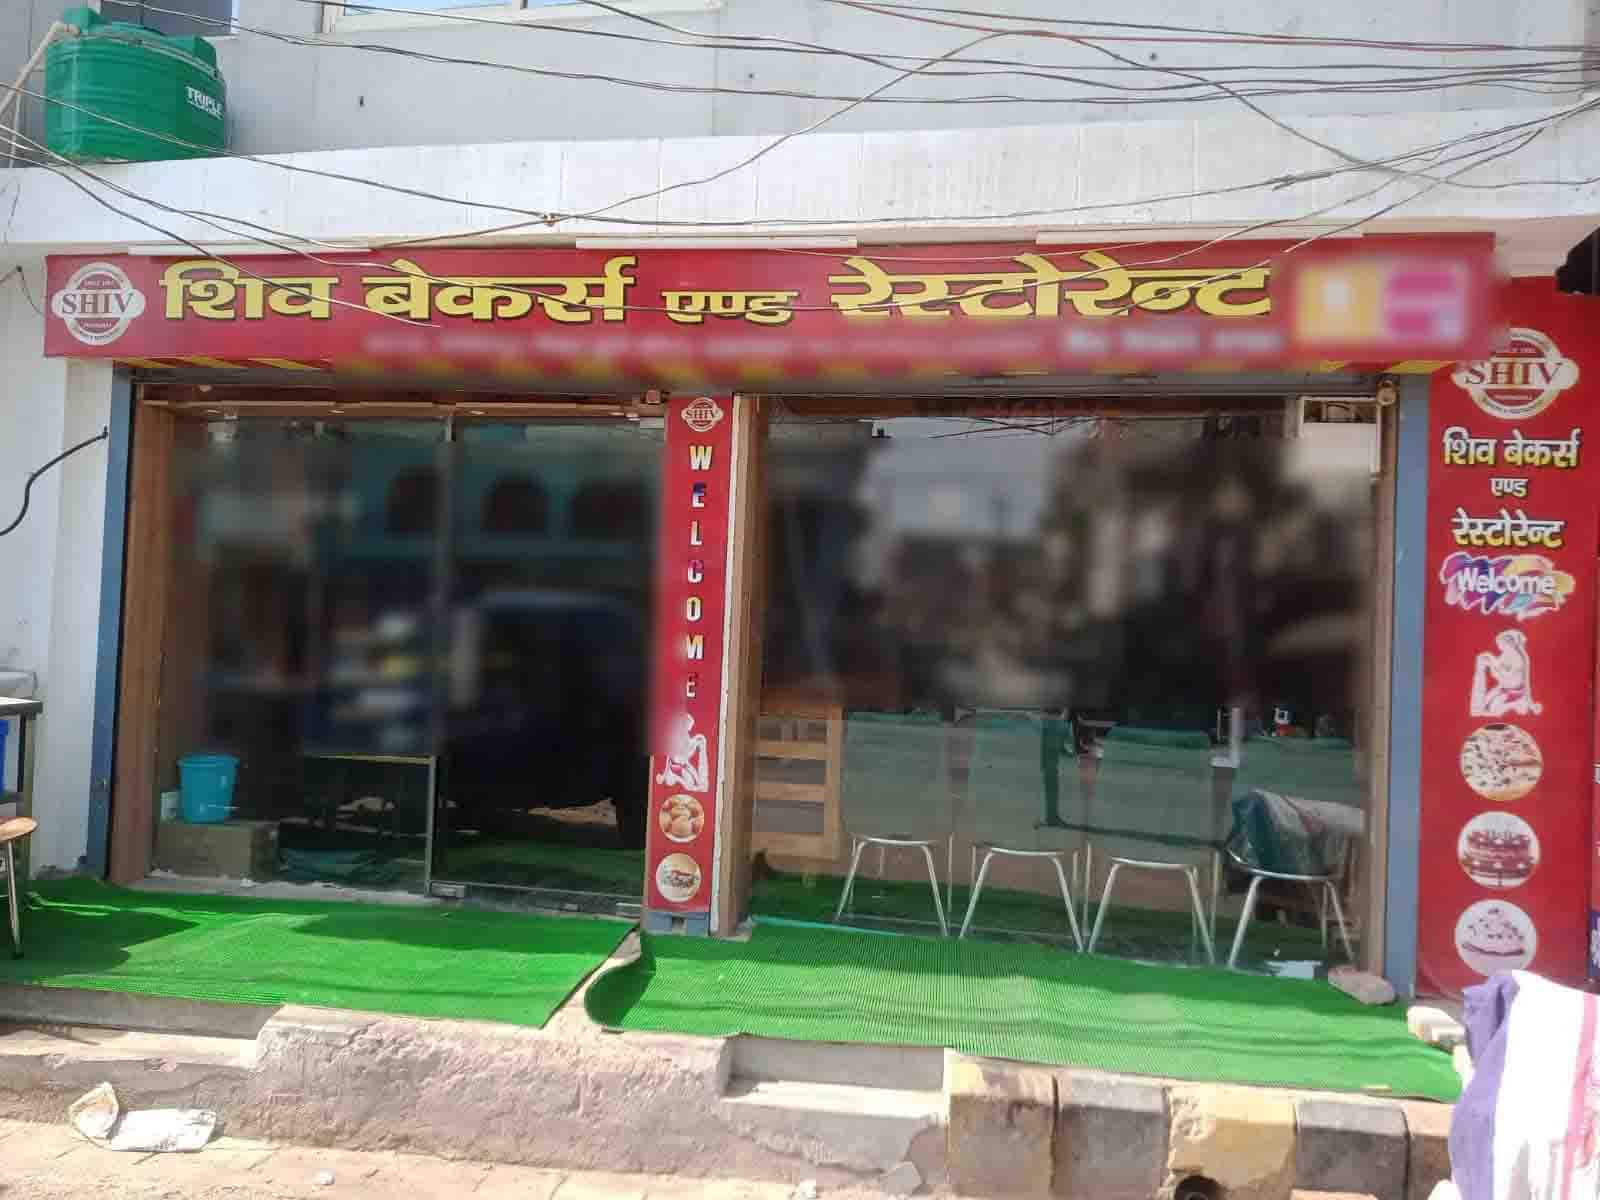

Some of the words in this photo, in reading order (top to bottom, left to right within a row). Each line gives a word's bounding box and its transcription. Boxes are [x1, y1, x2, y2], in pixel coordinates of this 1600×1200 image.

[62, 292, 134, 313] SHIV
[159, 259, 339, 320] शिव
[361, 256, 636, 322] बेकर्स
[662, 290, 799, 323] एण्ड
[828, 252, 1272, 318] रेस्टोरेन्ट
[1465, 361, 1563, 385] SHIV
[1442, 427, 1496, 466] शिव
[1503, 428, 1581, 468] बेकर्स
[1490, 477, 1529, 498] एण्ड
[1451, 507, 1565, 548] रेस्टोरेन्ट
[685, 444, 713, 699] WELCOME
[1457, 567, 1556, 594] Welcome
